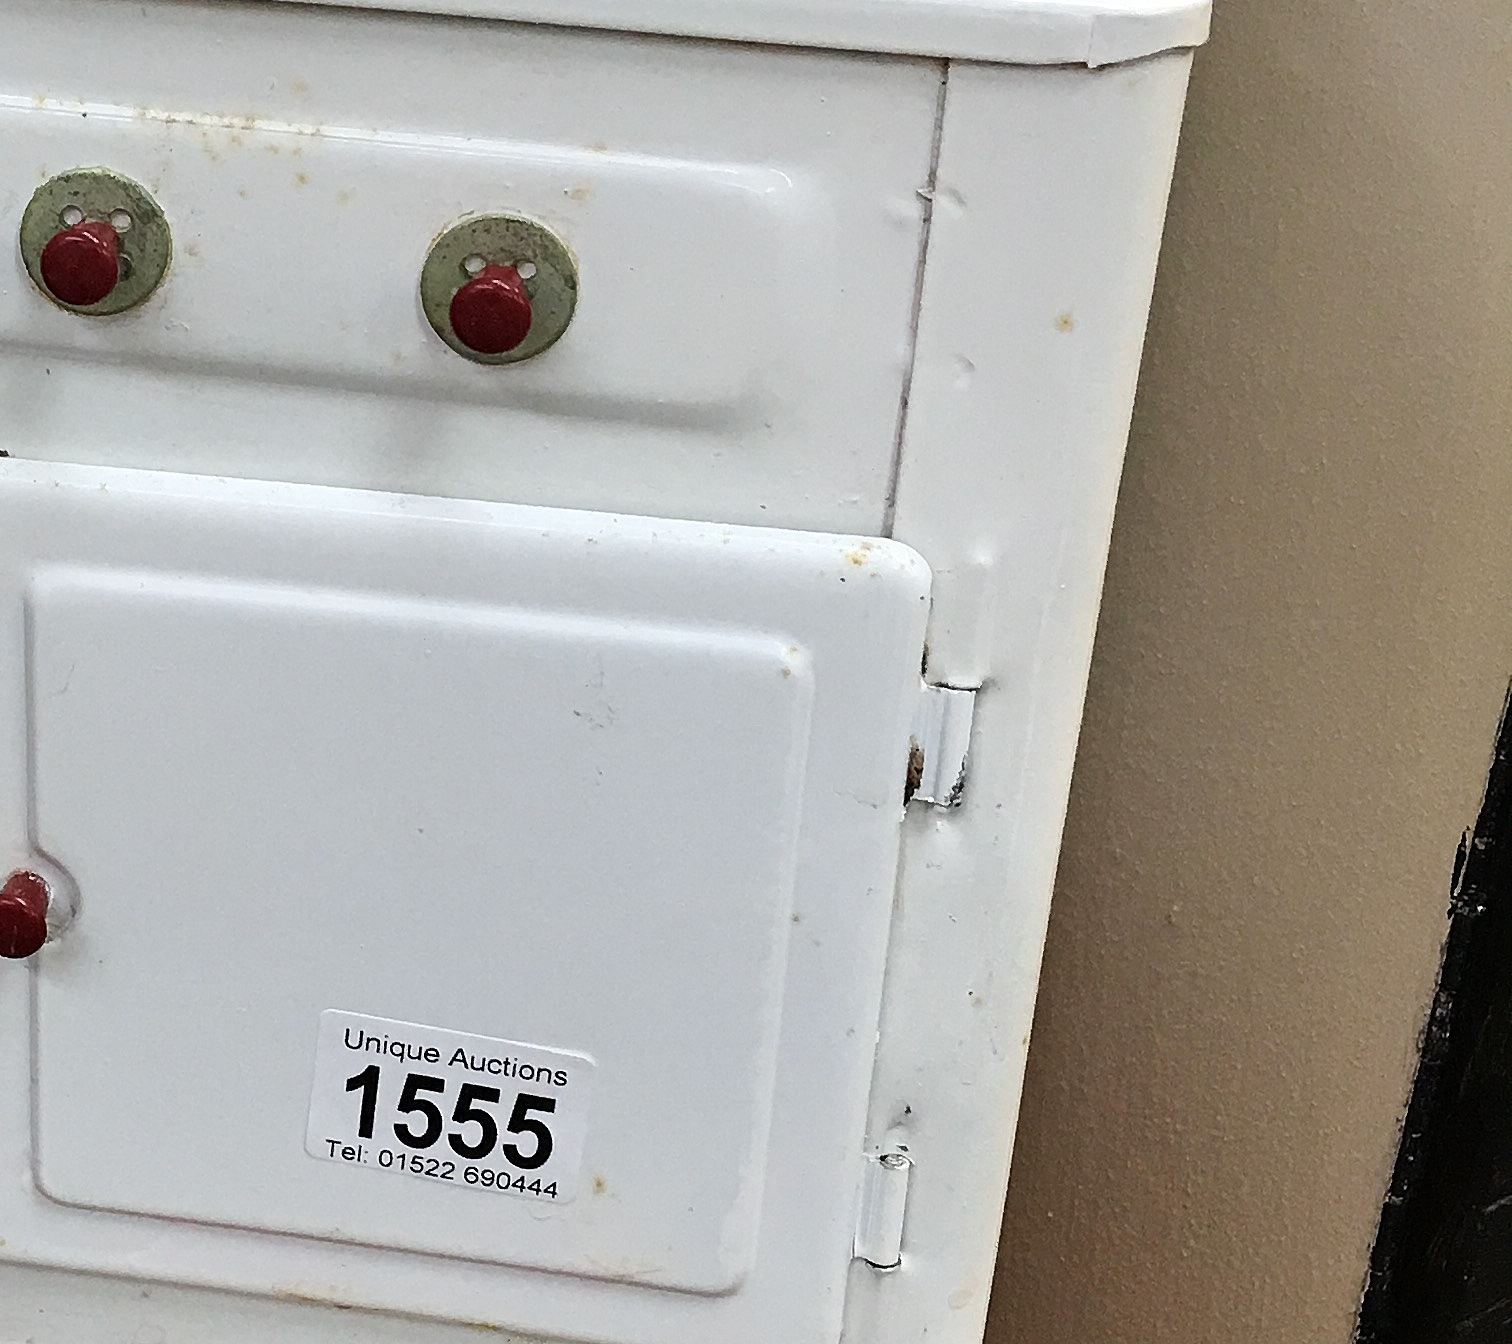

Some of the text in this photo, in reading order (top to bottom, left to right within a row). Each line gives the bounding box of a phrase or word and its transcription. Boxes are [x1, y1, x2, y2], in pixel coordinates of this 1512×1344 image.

[344, 1027, 568, 1087] Unique Auctions
[345, 1064, 557, 1170] 1555
[325, 1138, 558, 1198] Tel: 01522 690444
